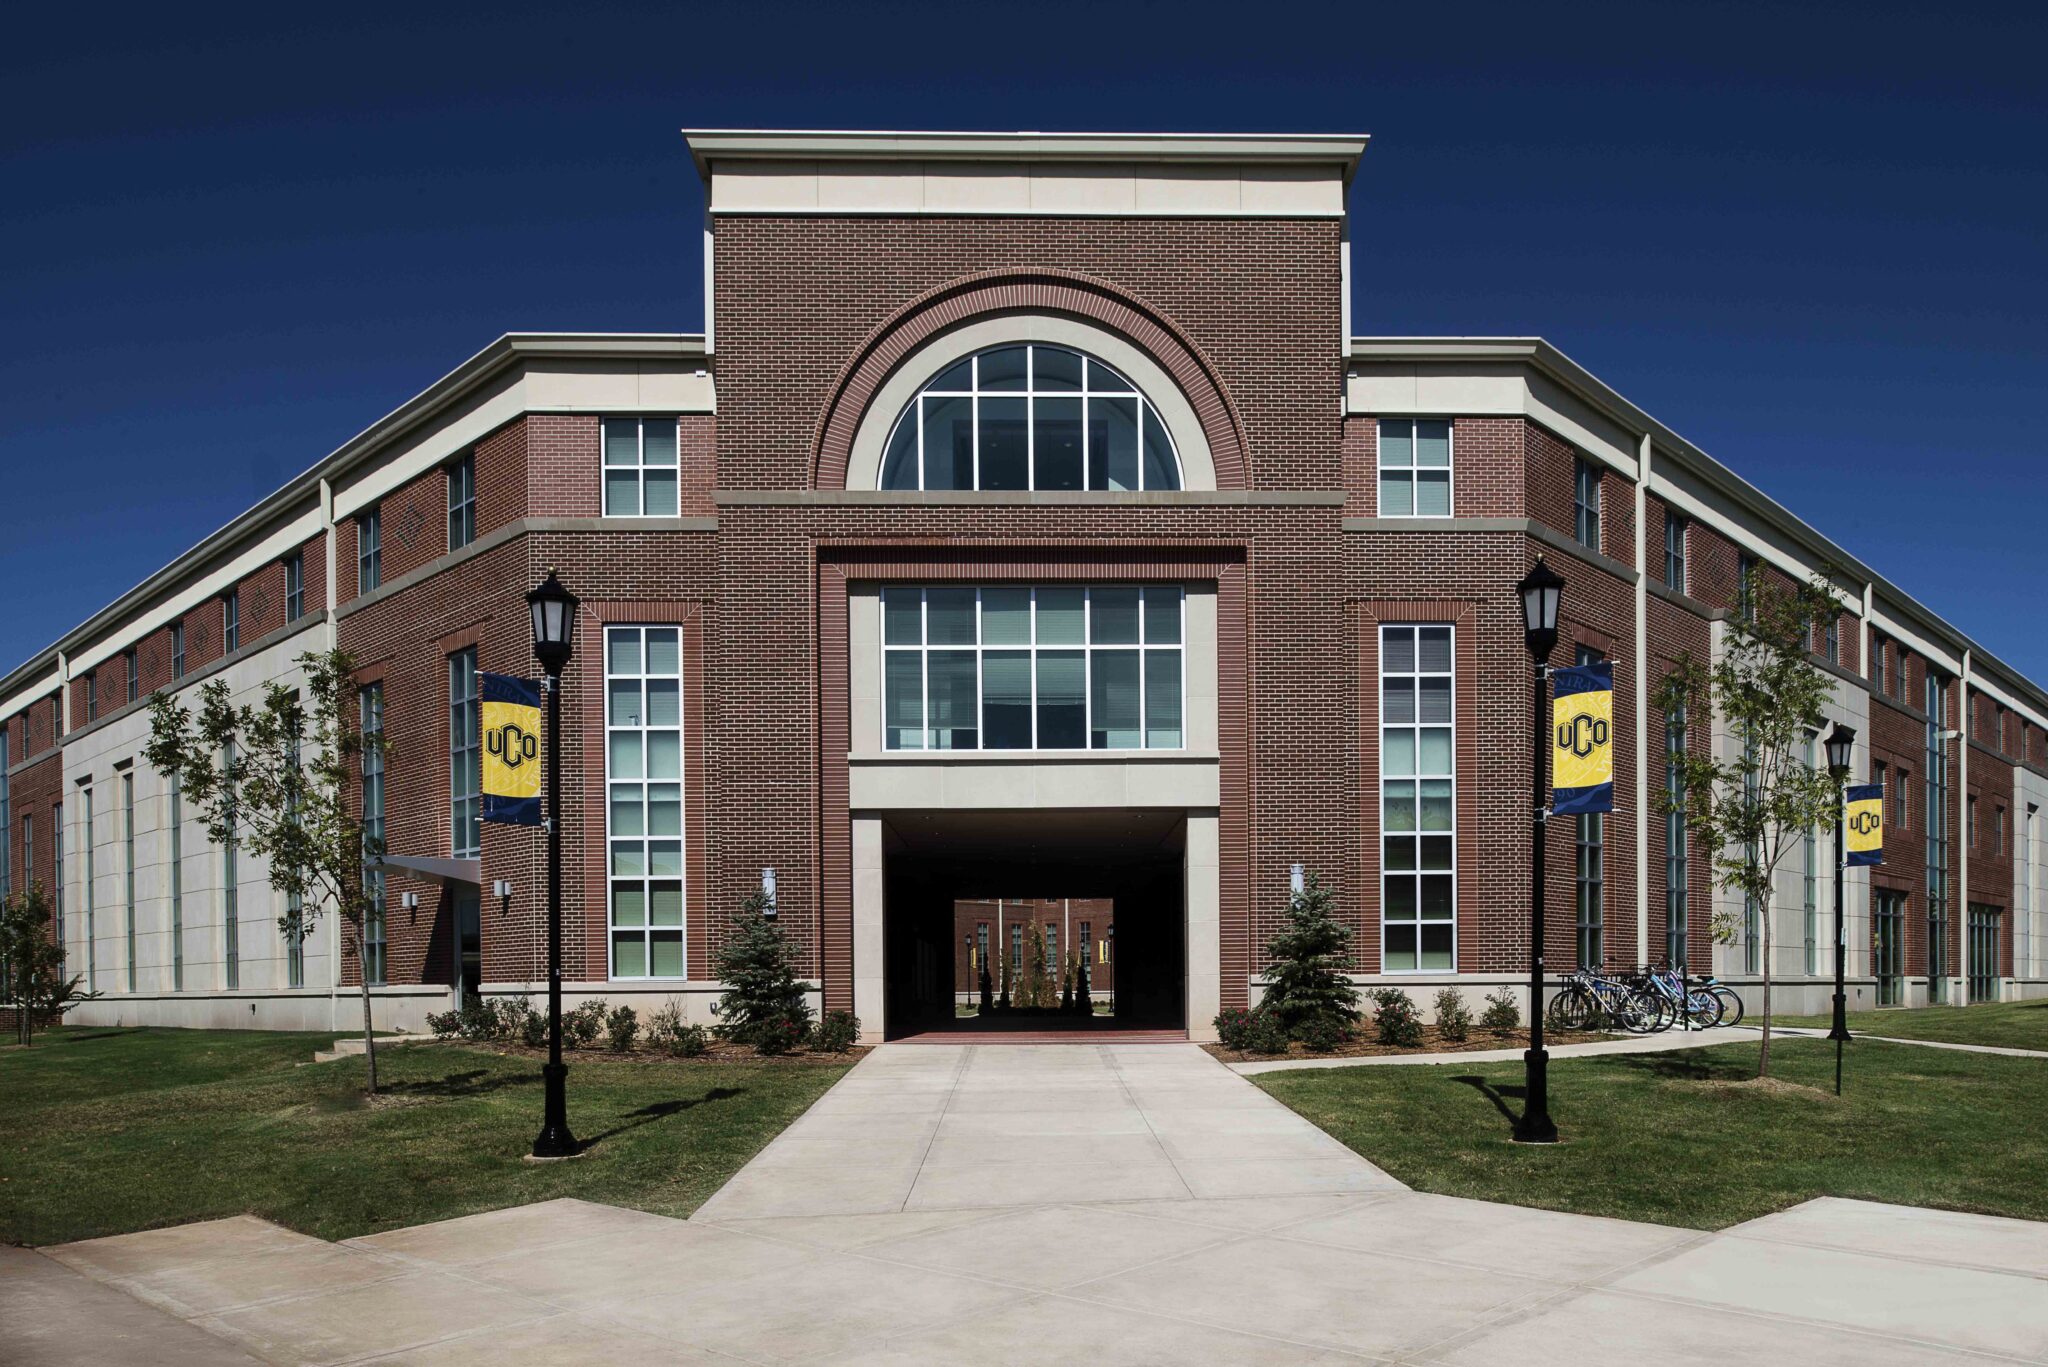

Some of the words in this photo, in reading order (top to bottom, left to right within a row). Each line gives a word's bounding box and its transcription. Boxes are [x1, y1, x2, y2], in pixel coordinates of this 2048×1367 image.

[486, 722, 538, 769] UCO
[1556, 712, 1609, 759] UCO
[1850, 811, 1879, 835] UCO
